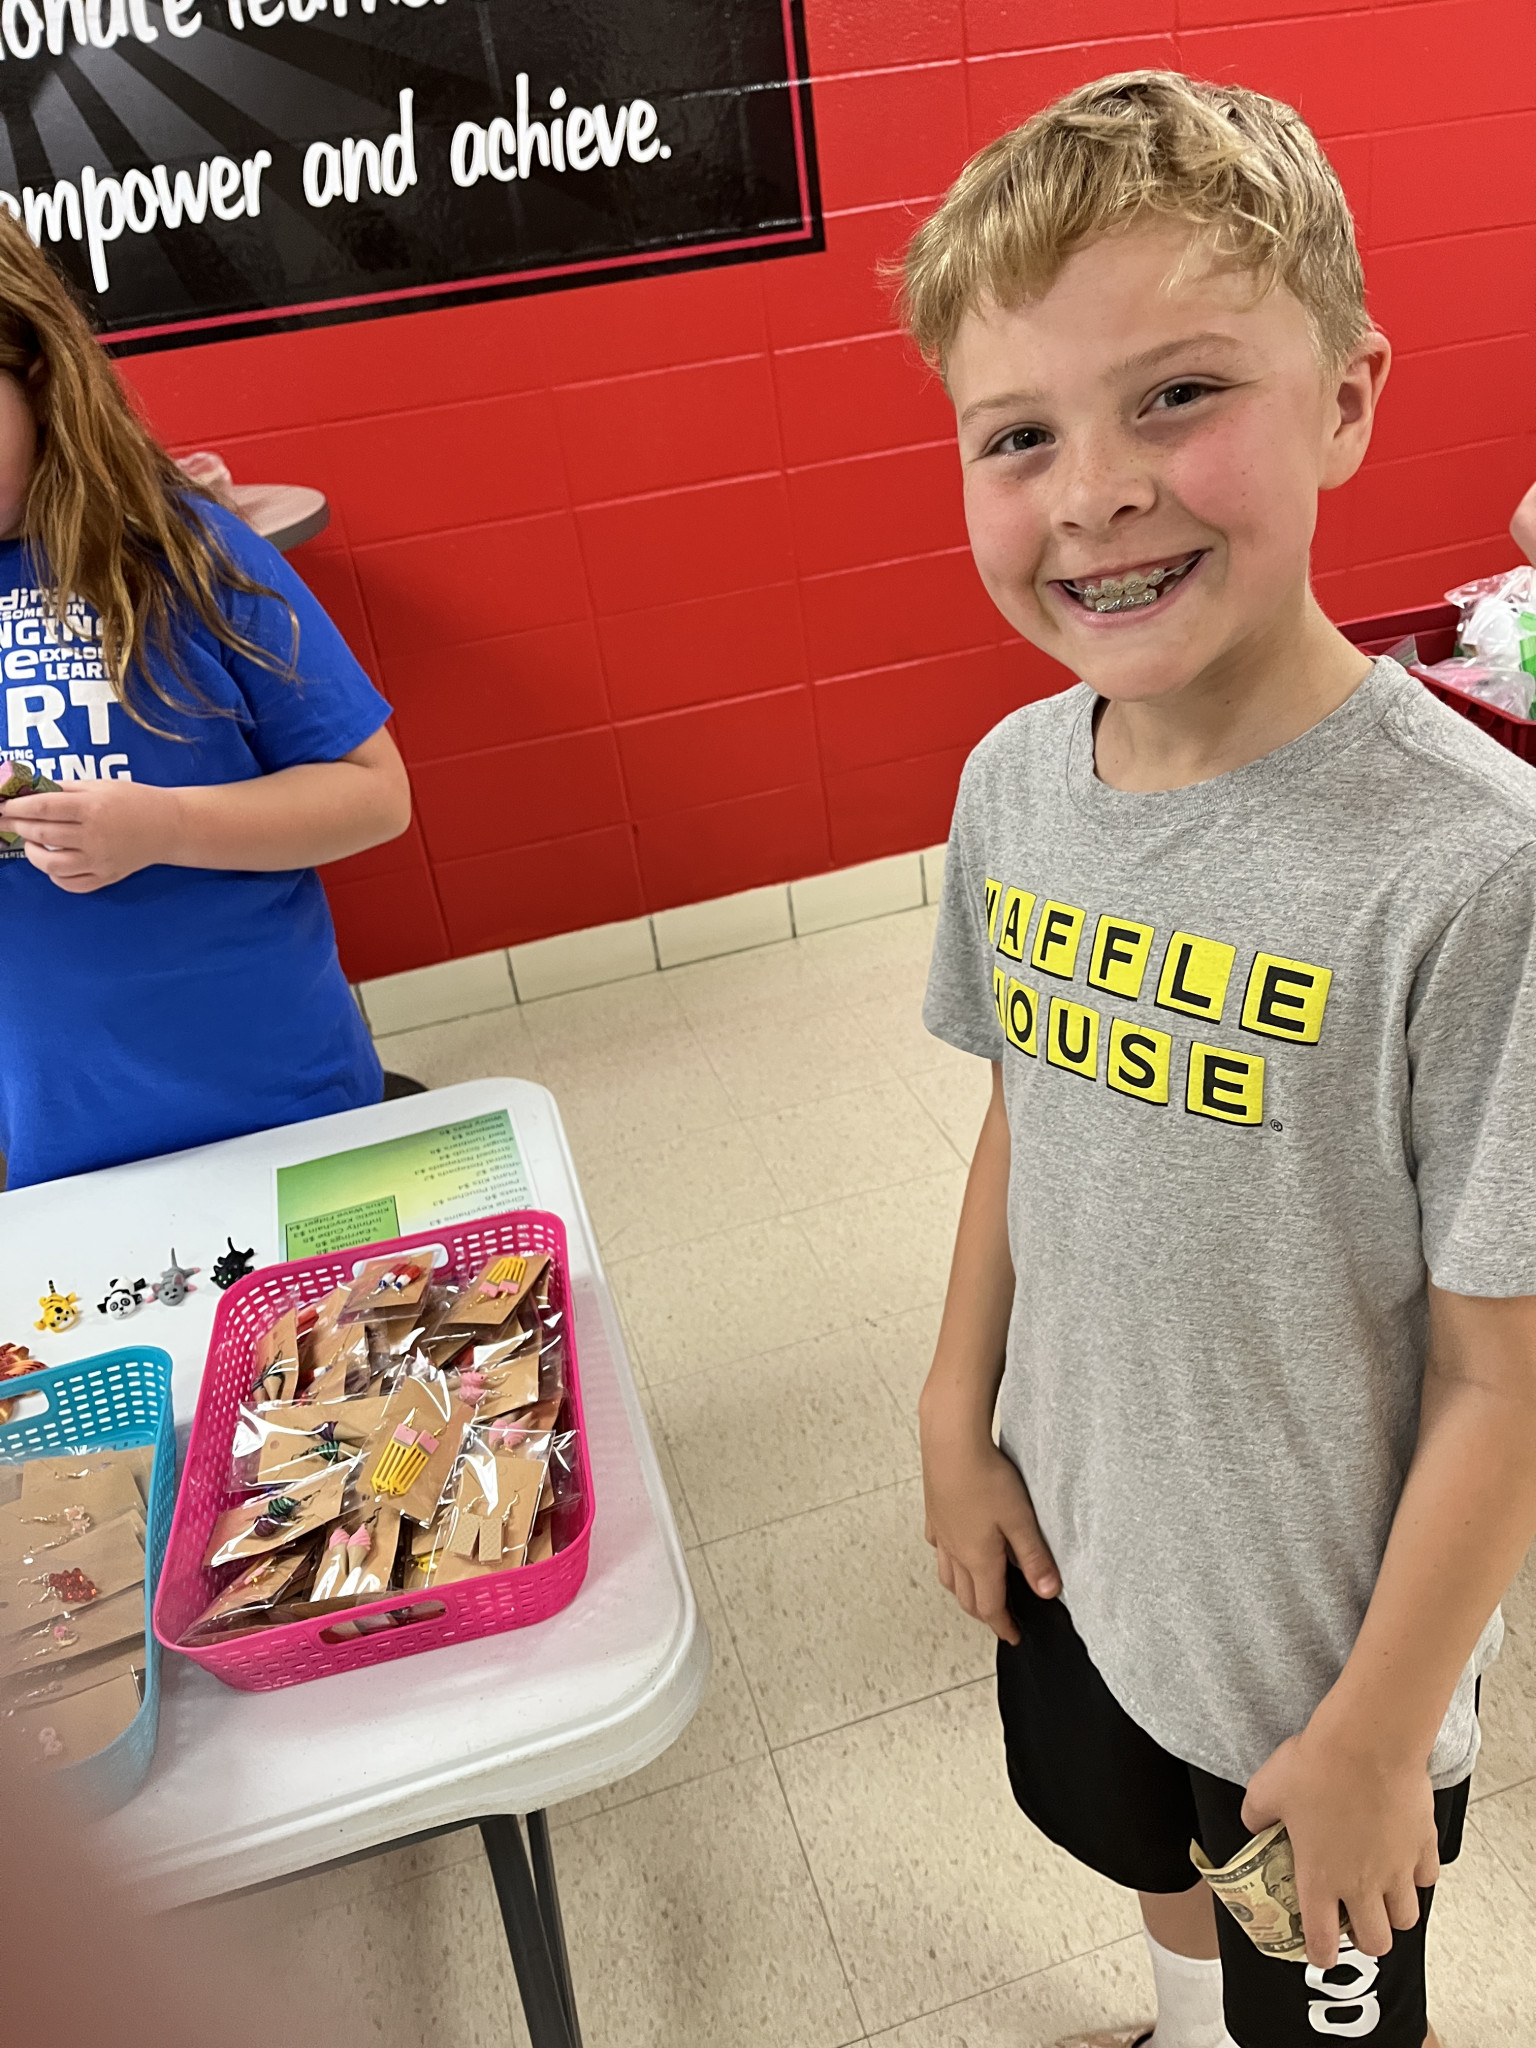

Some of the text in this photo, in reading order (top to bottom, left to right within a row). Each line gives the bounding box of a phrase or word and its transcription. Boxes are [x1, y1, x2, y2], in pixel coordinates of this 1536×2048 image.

[0, 0, 202, 60] onate
[303, 88, 418, 207] and
[451, 72, 673, 188] achieve.
[0, 680, 119, 749] RT
